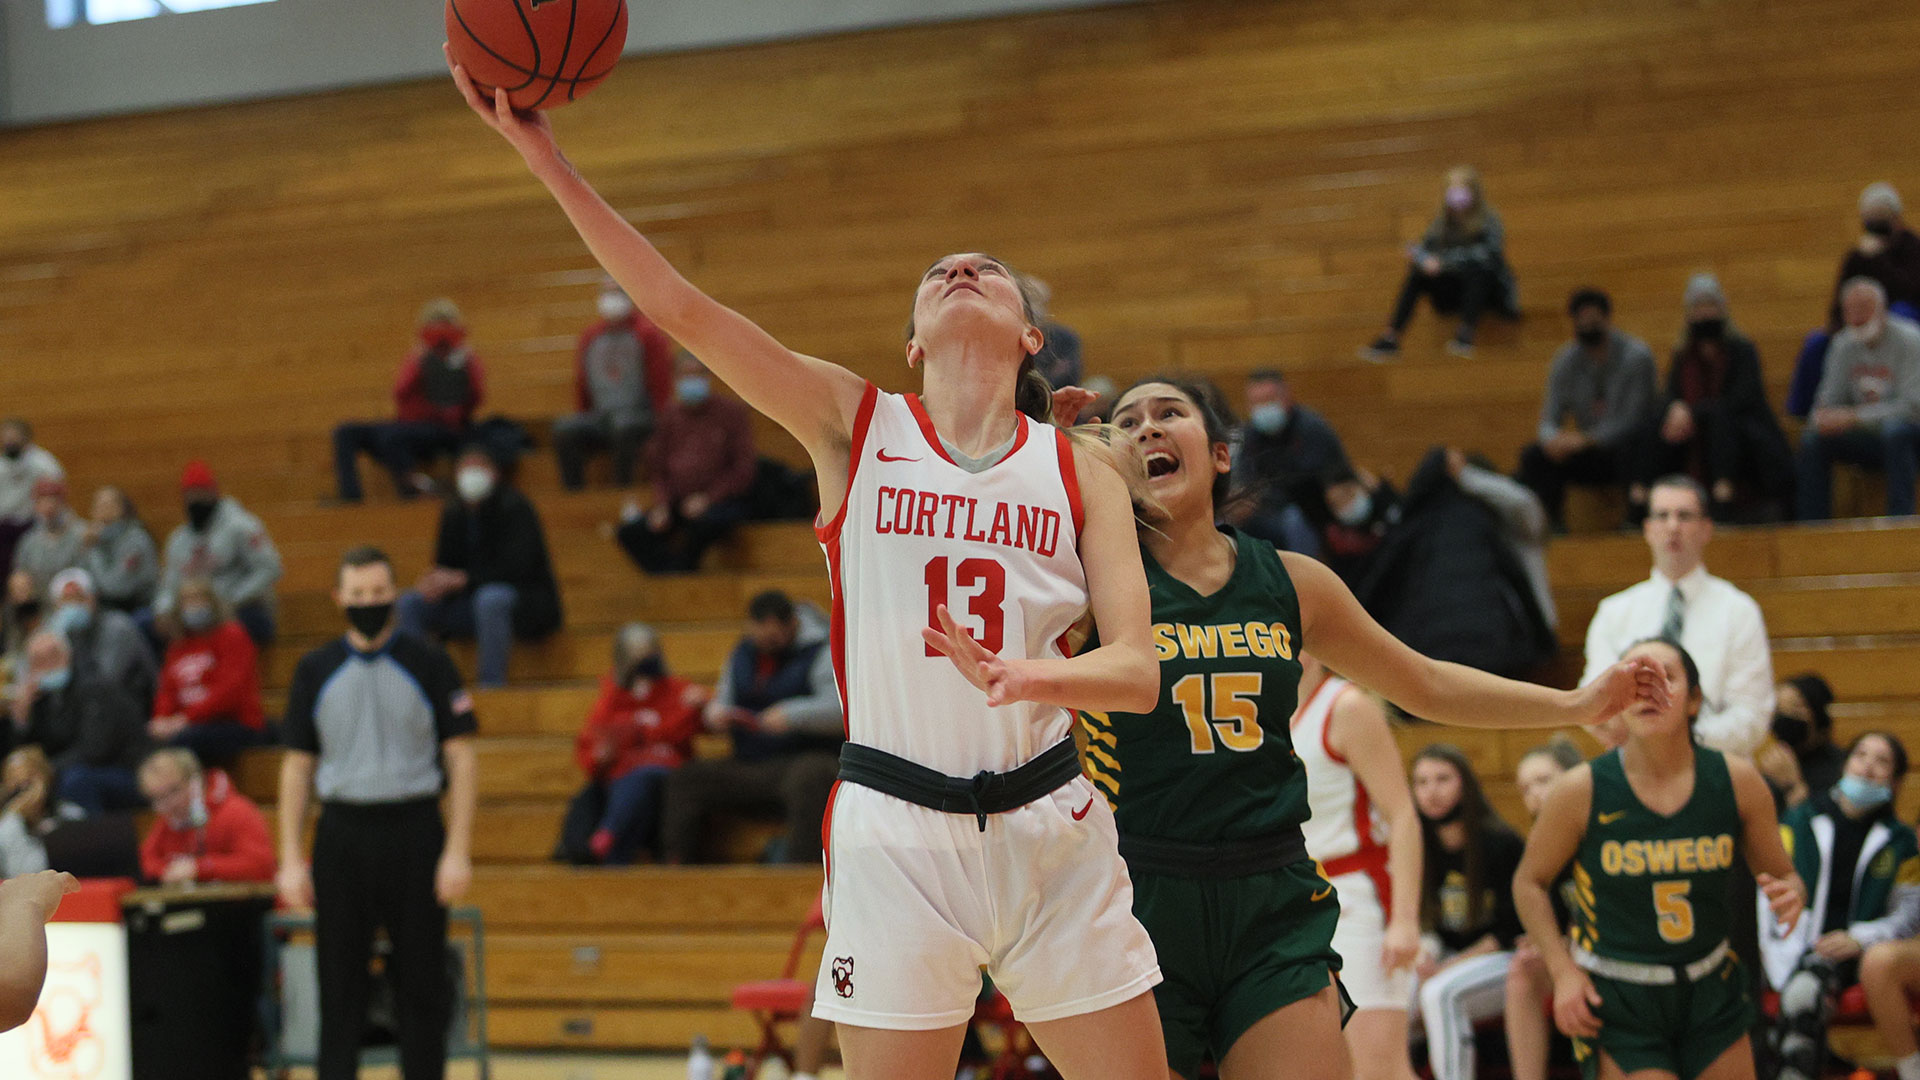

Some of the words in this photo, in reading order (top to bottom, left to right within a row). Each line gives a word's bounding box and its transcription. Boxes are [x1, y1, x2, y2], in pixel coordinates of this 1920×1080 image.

[876, 486, 1061, 558] CORTLAND
[924, 556, 1006, 657] 13
[1151, 621, 1293, 662] SWEGO
[1171, 672, 1264, 754] 15
[1600, 833, 1734, 876] OSWEGO
[1652, 879, 1694, 943] 5
